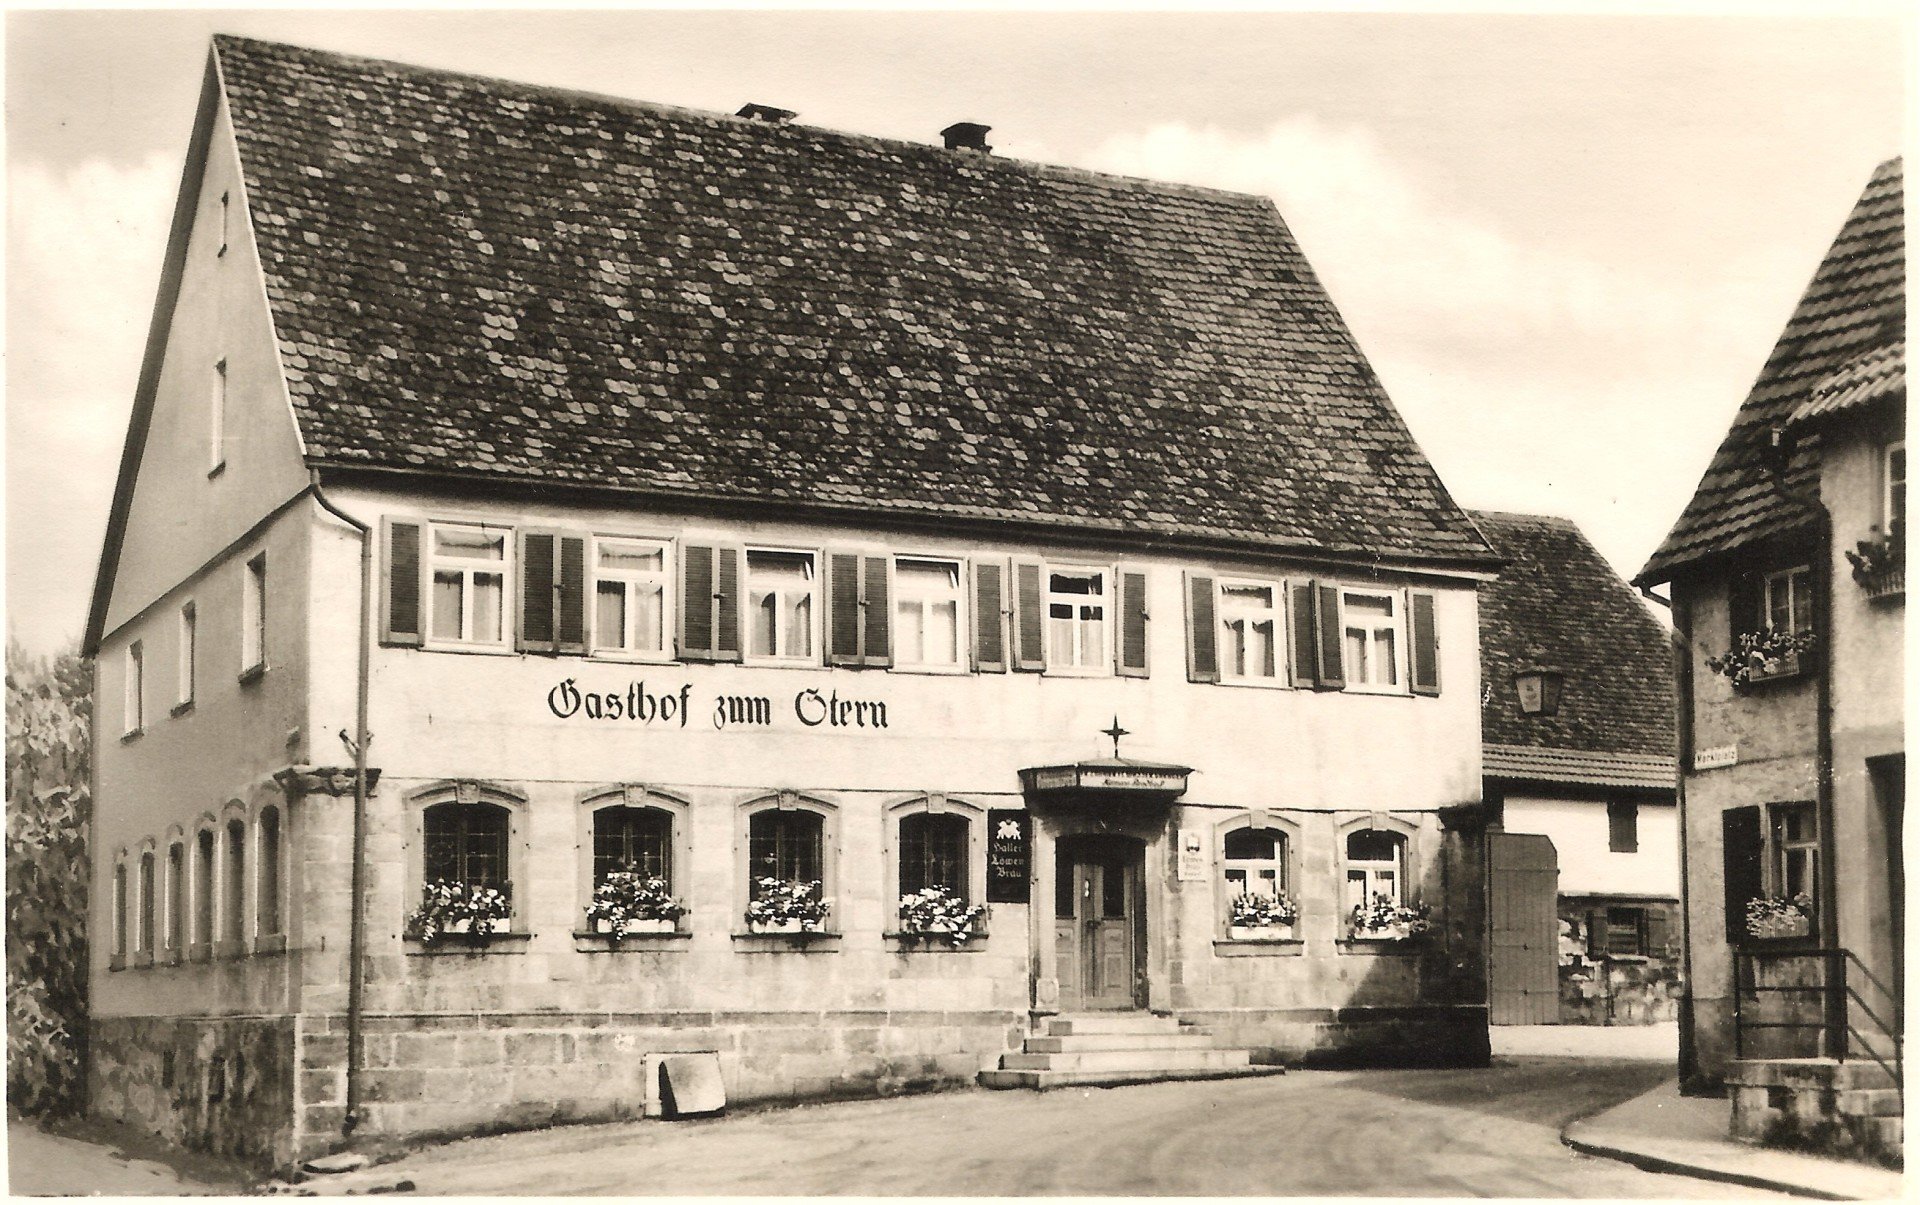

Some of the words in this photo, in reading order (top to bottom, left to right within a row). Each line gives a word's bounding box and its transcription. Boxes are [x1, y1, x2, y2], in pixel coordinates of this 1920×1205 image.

[547, 677, 694, 729] Gasthof
[712, 694, 772, 731] zum
[793, 687, 890, 729] Stern
